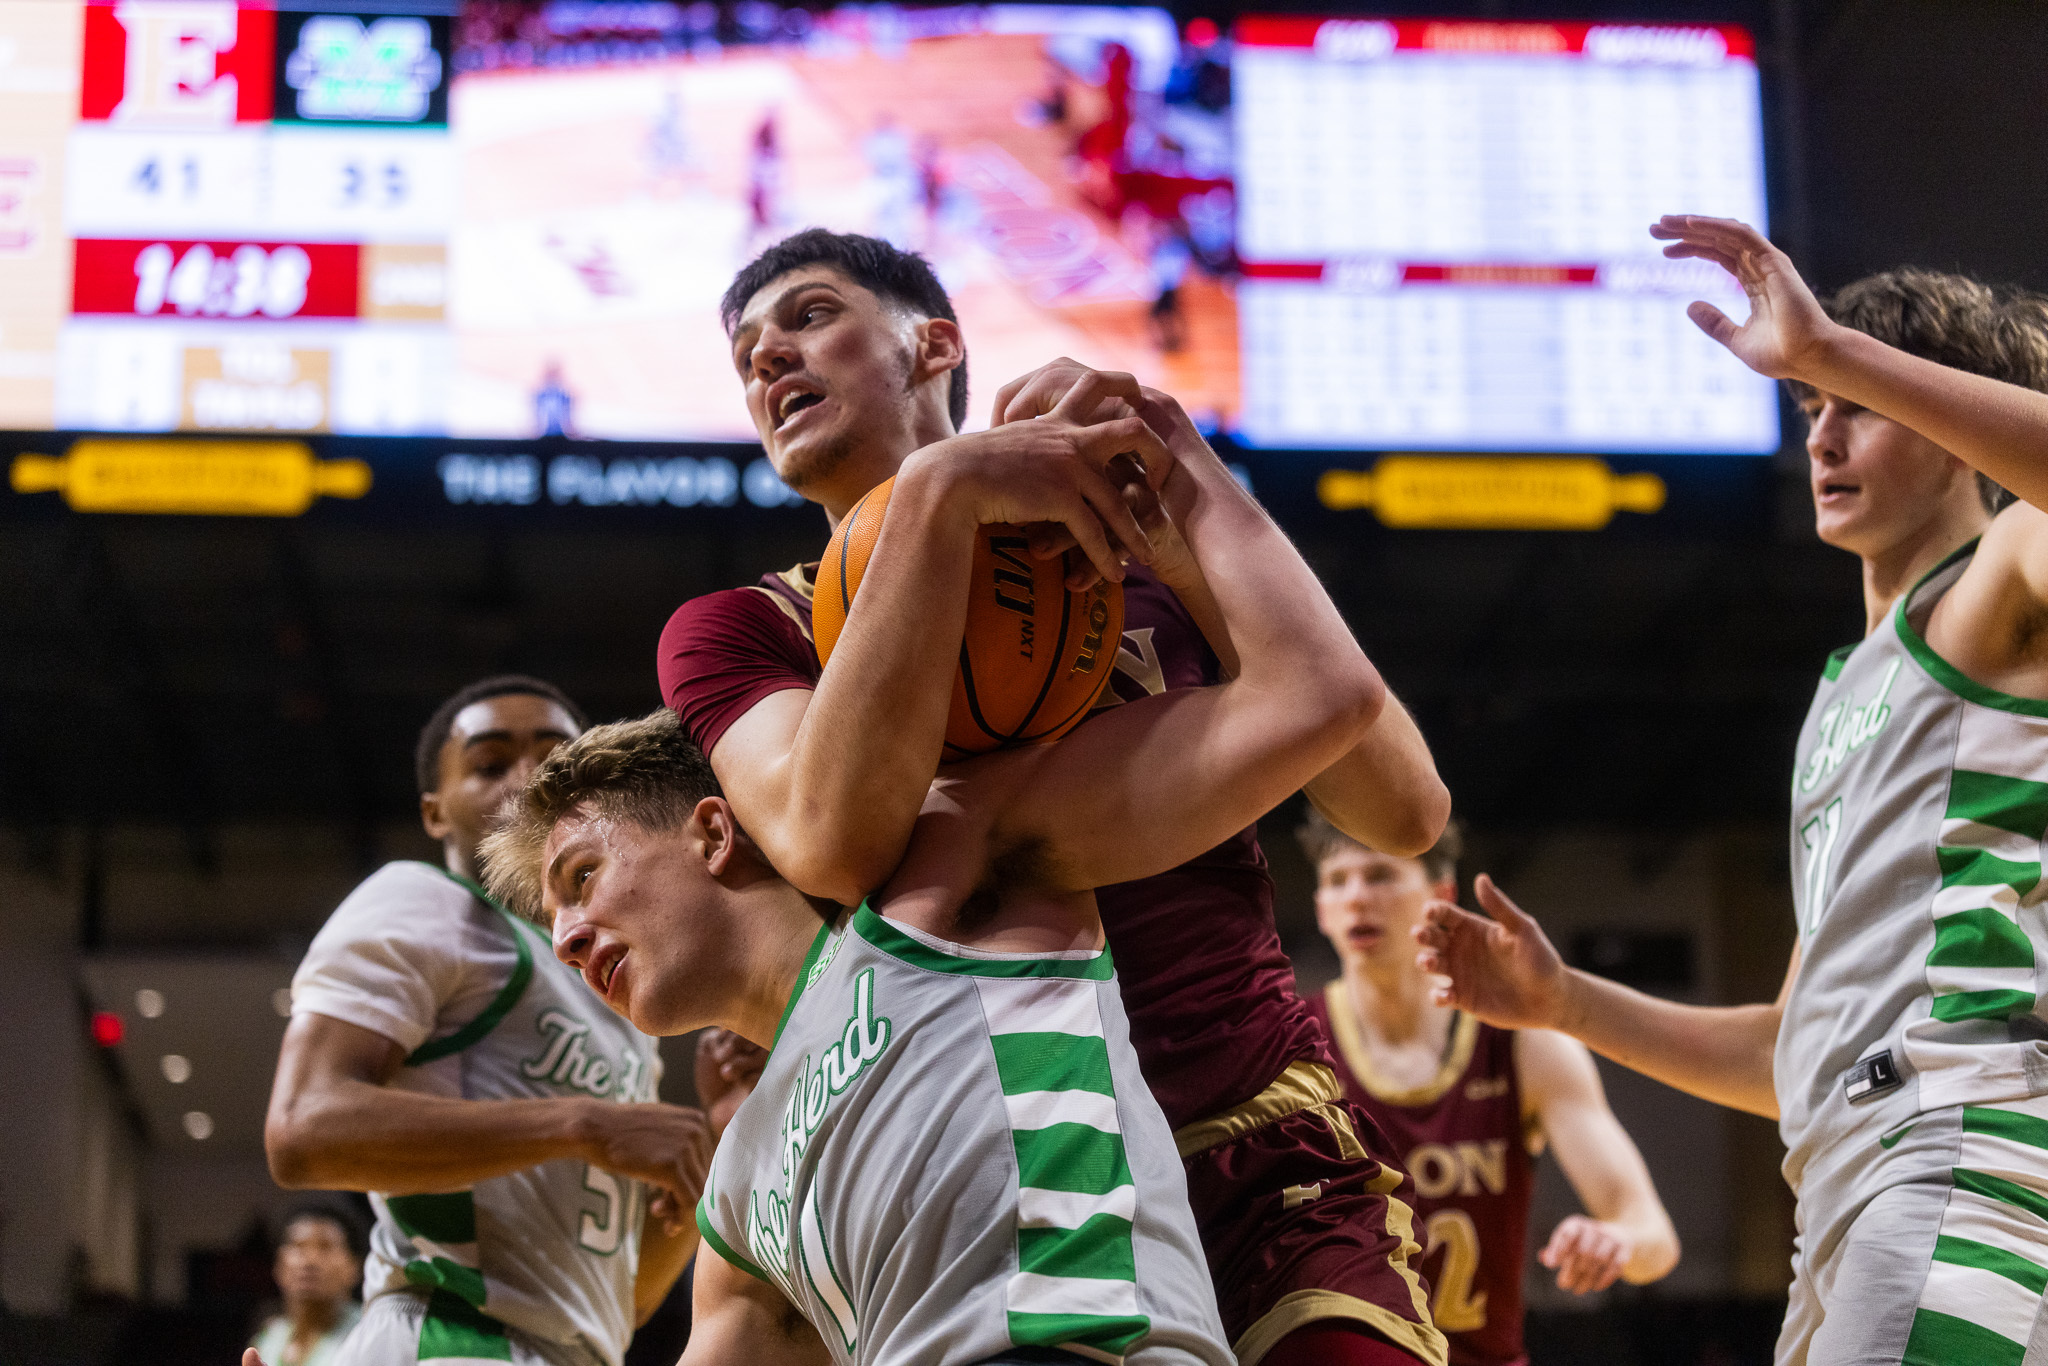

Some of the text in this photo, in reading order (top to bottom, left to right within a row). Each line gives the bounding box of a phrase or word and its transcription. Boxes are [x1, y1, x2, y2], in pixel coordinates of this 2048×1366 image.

[131, 153, 200, 198] 41
[438, 455, 541, 504] THE
[1020, 619, 1035, 663] NXT
[1800, 655, 1900, 793] Herd
[522, 1008, 612, 1097] The
[1874, 1064, 1887, 1081] L
[782, 966, 892, 1204] Herd
